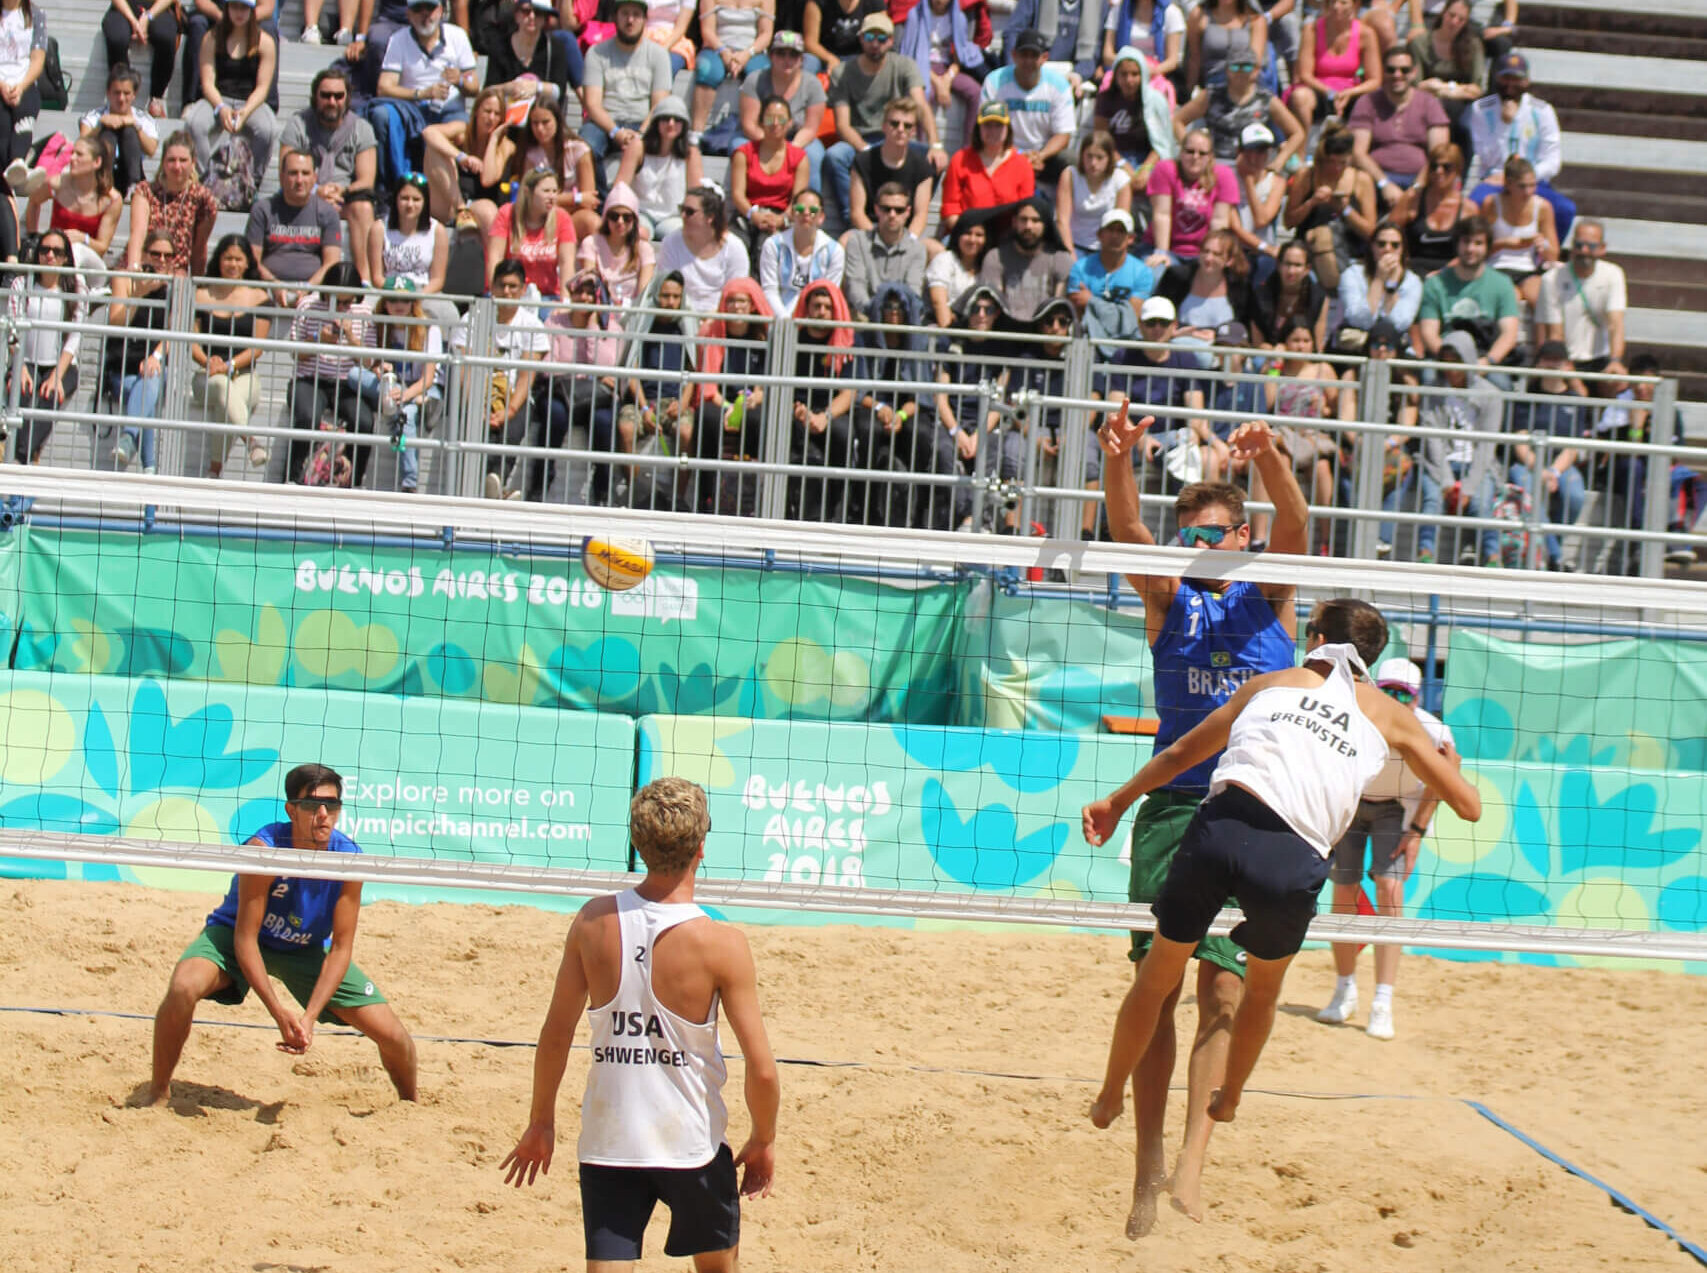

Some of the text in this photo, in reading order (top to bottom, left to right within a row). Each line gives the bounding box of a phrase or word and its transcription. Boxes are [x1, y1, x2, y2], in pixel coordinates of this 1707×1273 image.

[296, 560, 425, 598] BUENOS
[432, 568, 518, 603] AIRES
[526, 574, 602, 609] 2018
[1188, 612, 1200, 637] 1
[1188, 666, 1255, 696] BRASI
[1299, 696, 1351, 732] USA
[341, 776, 575, 808] Explore more on
[741, 774, 892, 816] BUENOS
[334, 810, 592, 841] lympicchannel.com
[762, 814, 867, 853] AIRES
[763, 853, 867, 888] 2018
[272, 883, 289, 898] 2
[634, 946, 646, 962] 2
[612, 1011, 664, 1039] USA
